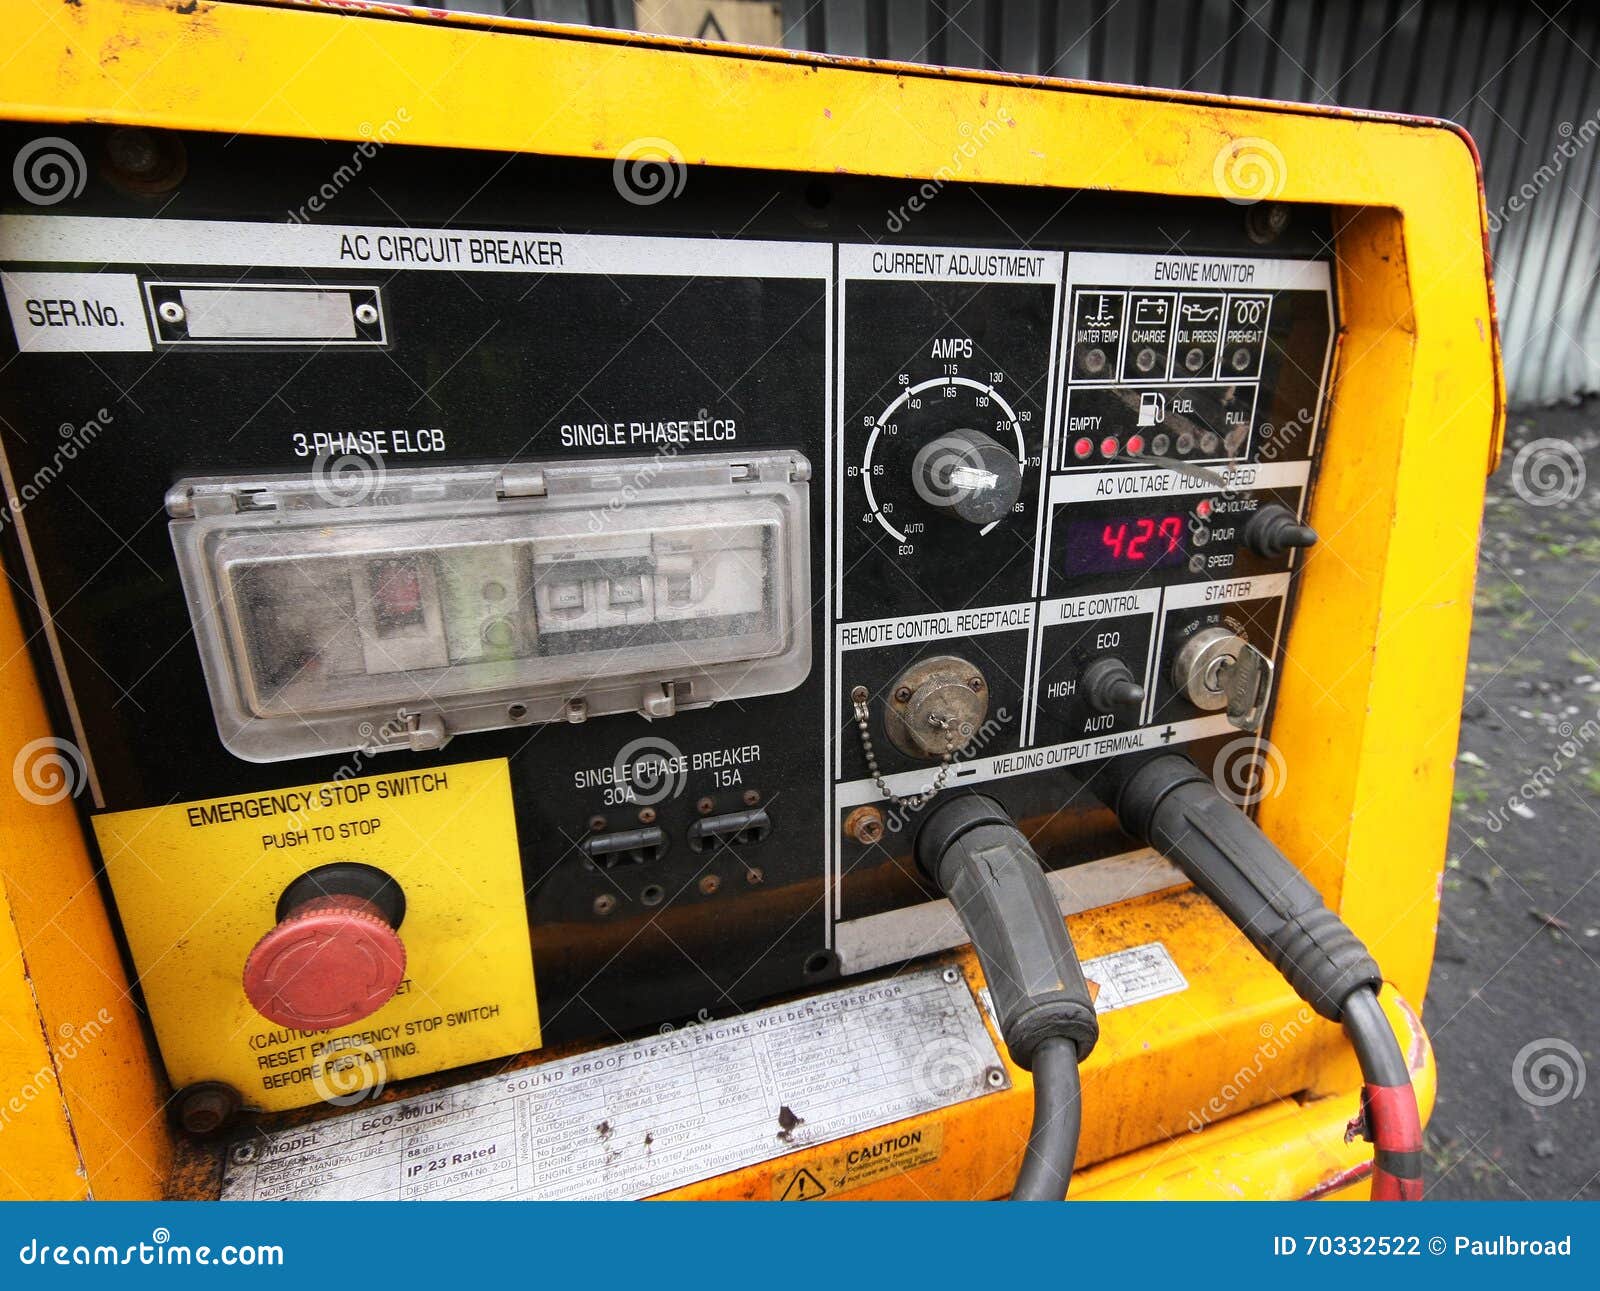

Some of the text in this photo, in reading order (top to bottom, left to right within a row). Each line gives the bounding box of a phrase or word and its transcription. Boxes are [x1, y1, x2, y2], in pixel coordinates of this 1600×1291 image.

[340, 234, 563, 266] AC CIRCUIT BREAKER
[872, 251, 1045, 278] CURRENT ADJUSTMENT
[1155, 261, 1254, 283] ENGINE MONITOR
[26, 299, 124, 328] SER.No.
[1077, 329, 1119, 343] WATER TEMP
[1132, 329, 1166, 343] CHARGE
[1177, 330, 1217, 343] OIL PRESS
[1227, 330, 1264, 343] PREHEAT
[931, 338, 973, 359] AMPS
[943, 364, 958, 375] 115
[989, 372, 1003, 383] 130
[898, 374, 910, 385] 95
[942, 387, 957, 398] 165
[906, 399, 922, 410] 140
[975, 397, 989, 408] 190
[1172, 400, 1195, 414] FUEL
[863, 416, 875, 427] 80
[1018, 411, 1032, 422] 150
[1069, 416, 1102, 431] EMPTY
[1225, 412, 1246, 425] FULL
[883, 424, 898, 435] 110
[996, 420, 1011, 431] 210
[561, 420, 736, 448] SINGLE PHASE ELCB
[293, 429, 445, 457] 3-PHASE ELCB
[1027, 457, 1041, 467] 170
[847, 467, 858, 477] 60
[873, 465, 885, 476] 85
[1096, 478, 1114, 496] AC
[1118, 474, 1170, 493] VOLTAGE
[1222, 469, 1257, 486] SPEED
[882, 503, 894, 513] 60
[1227, 499, 1259, 512] VOLTAGE
[863, 513, 874, 523] 40
[903, 523, 924, 534] AUTO
[1211, 528, 1235, 541] HOUR
[1103, 517, 1184, 561] 427
[898, 545, 915, 556] ECO
[1208, 554, 1234, 568] SPEED
[1205, 581, 1252, 601] STARTER
[1060, 595, 1140, 620] IDLE CONTROL
[842, 607, 1031, 646] REMOTE CONTROL RECEPTACLE
[1183, 619, 1200, 636] STOP
[1096, 632, 1121, 649] ECO
[1048, 680, 1077, 699] HIGH
[1083, 713, 1115, 733] AUTO
[993, 733, 1145, 775] WELDING OUTPUT TERMINAL
[574, 744, 760, 789] SINGLE PHASE BREAKER
[713, 768, 743, 788] 15A
[187, 772, 449, 828] EMERGENCY STOP SWITCH
[603, 785, 637, 806] 30A
[262, 818, 382, 851] PUSH TO STOP
[257, 1004, 500, 1070] RESET EMERGENCY STOP SWITCH
[507, 1071, 564, 1093] SOUND
[571, 1055, 626, 1077] PROOF
[633, 1037, 690, 1061] DIESEL
[694, 1021, 751, 1046] ENGINE
[263, 1042, 420, 1090] BEFORE RESTARTING.
[535, 1111, 555, 1123] ECO
[265, 1133, 320, 1157] MODEL
[362, 1114, 393, 1132] ECO
[536, 1134, 561, 1147] Rated
[408, 1148, 421, 1159] 88
[537, 1143, 572, 1159] No Load
[847, 1131, 923, 1165] CAUTION
[260, 1146, 385, 1185] YEAR OF MANUFACTURE
[407, 1165, 423, 1178] IP
[428, 1158, 448, 1172] 23
[452, 1143, 497, 1165] Rated
[538, 1153, 574, 1170] ENGINE
[538, 1166, 574, 1183] ENGINE
[260, 1173, 334, 1199] NOISE LEVELS
[406, 1181, 443, 1197] DIESEL
